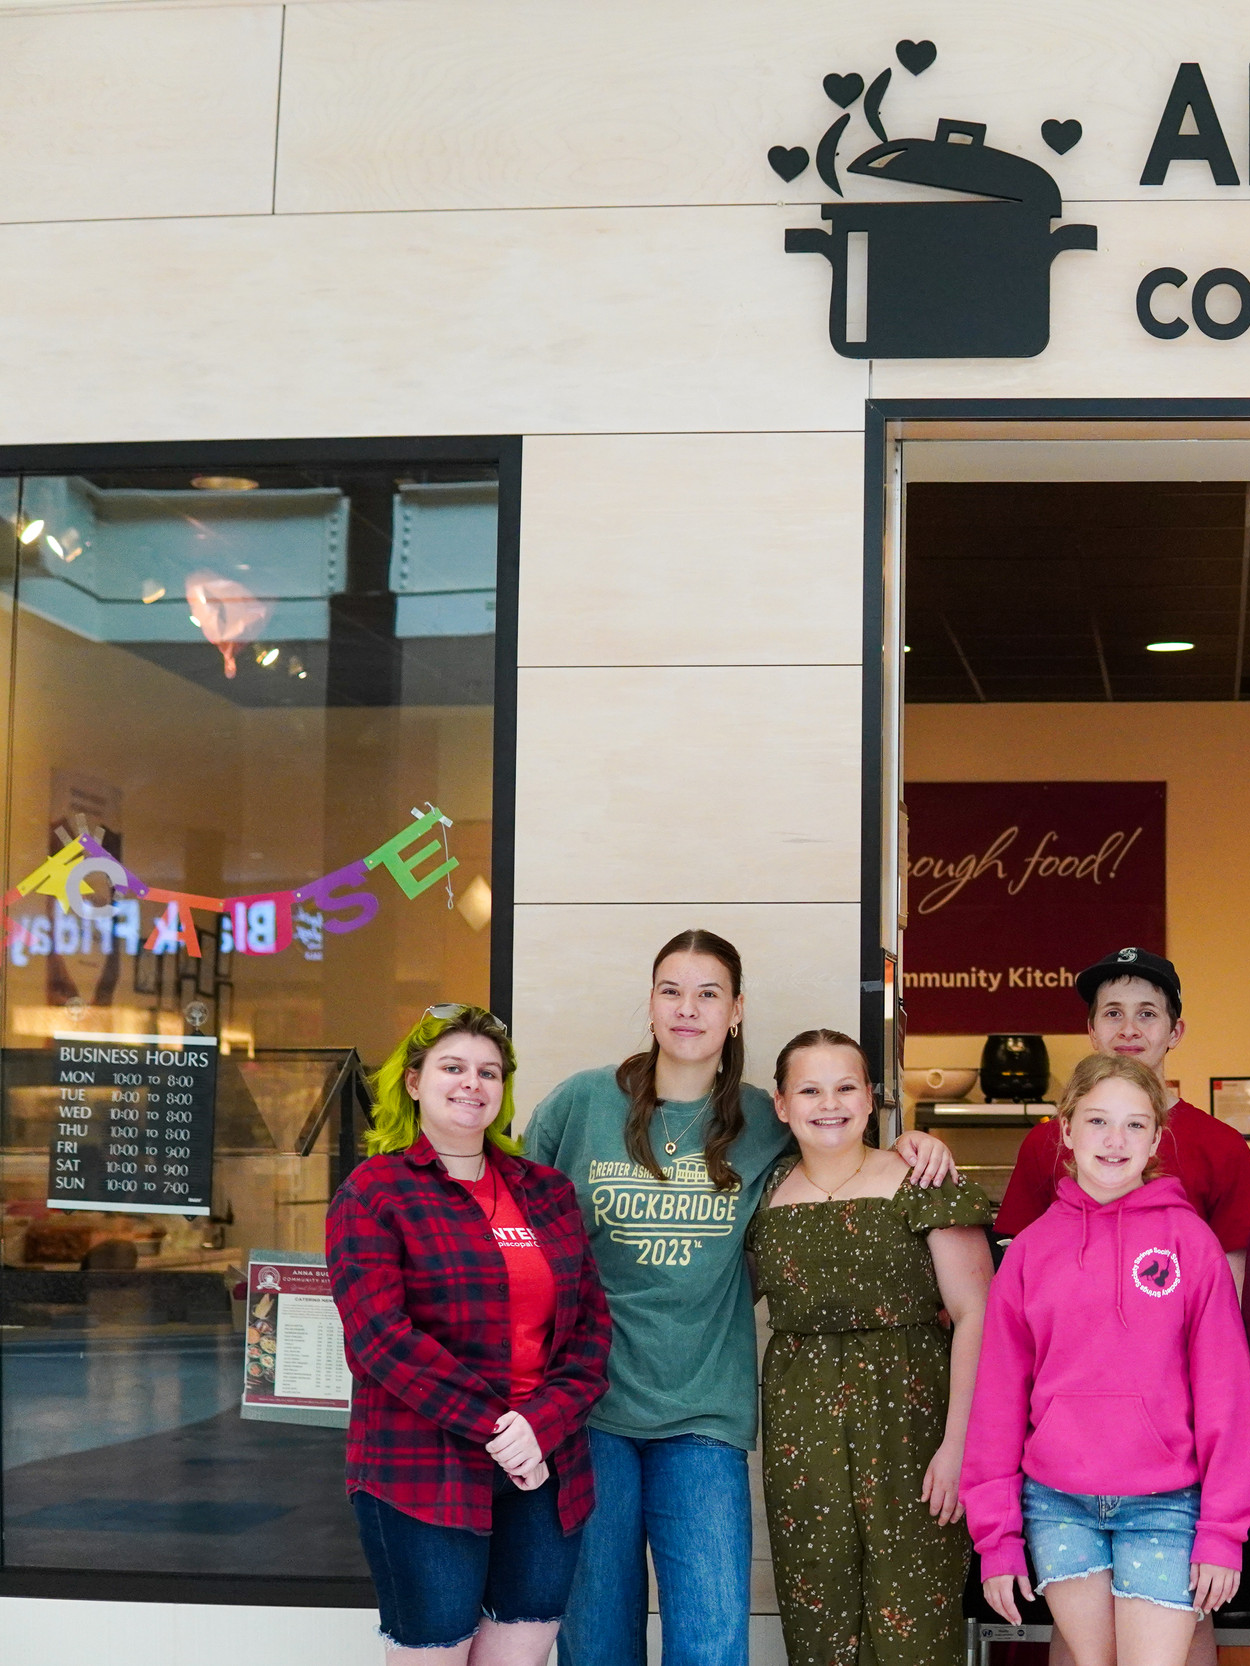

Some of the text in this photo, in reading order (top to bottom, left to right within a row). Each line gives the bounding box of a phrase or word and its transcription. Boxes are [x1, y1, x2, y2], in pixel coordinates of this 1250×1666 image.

[1008, 827, 1143, 895] food!
[1117, 947, 1138, 963] S
[60, 1046, 209, 1068] BUSINESS HOURS
[60, 1071, 95, 1084] MON
[113, 1073, 142, 1085] 10:00
[167, 1075, 194, 1088] 8:00
[60, 1088, 86, 1101] TUE
[111, 1091, 140, 1103] 10:00
[166, 1093, 193, 1105] 8:00
[59, 1106, 92, 1119] WED
[110, 1108, 139, 1121] 10:00
[165, 1111, 192, 1123] 8:00
[58, 1123, 88, 1137] THU
[110, 1126, 138, 1139] 10:00
[165, 1129, 191, 1141] 8:00
[56, 1141, 78, 1154] FRI
[109, 1144, 139, 1156] 10:00
[165, 1147, 190, 1159] 9:00
[56, 1159, 81, 1172] SAT
[106, 1161, 136, 1174] 10:00
[163, 1164, 189, 1177] 9:00
[589, 1160, 674, 1183] GREATER ASHRN
[55, 1177, 85, 1190] SUN
[106, 1179, 137, 1192] 10:00
[162, 1182, 189, 1194] 7:00
[592, 1185, 739, 1226] ROCKBRIDGE
[636, 1238, 692, 1266] 2023
